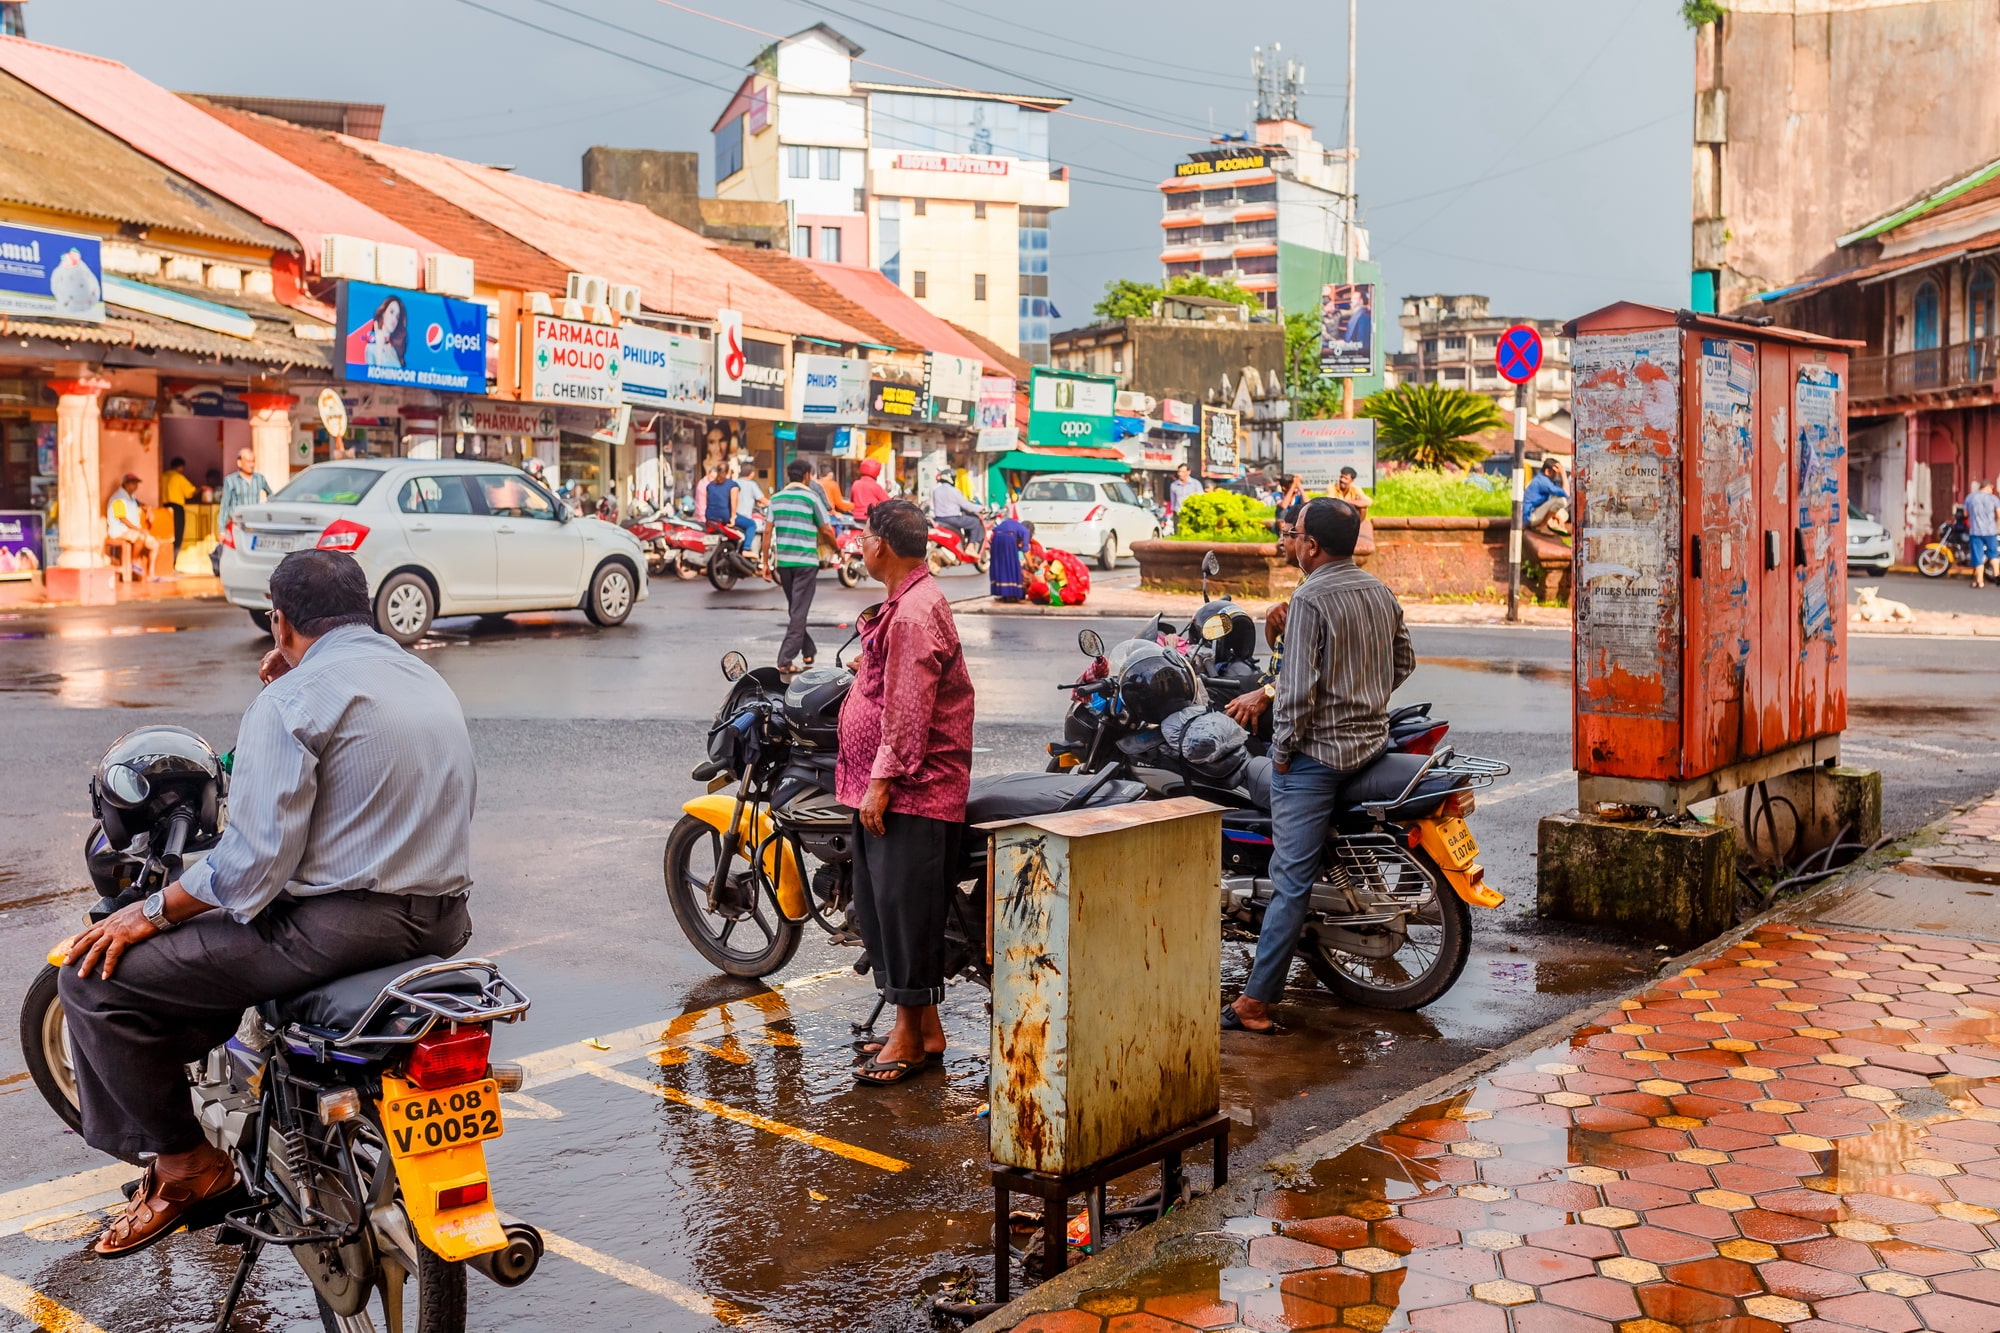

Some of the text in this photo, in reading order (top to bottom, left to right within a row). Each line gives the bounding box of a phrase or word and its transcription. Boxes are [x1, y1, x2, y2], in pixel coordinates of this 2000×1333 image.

[901, 156, 944, 171] HOTEL
[1177, 155, 1265, 177] HOTEL POONAM
[445, 333, 482, 353] pepsi
[537, 320, 620, 351] FARMACIA
[553, 347, 605, 371] MOLIO
[623, 345, 667, 368] PHILIPS
[367, 366, 469, 389] KOHINOOR RESTAURANT
[807, 373, 838, 388] PHILIPS
[552, 382, 605, 402] CHEMIST
[475, 412, 539, 433] PHARMACY
[1061, 420, 1092, 437] oppo
[1594, 586, 1658, 597] PILES CLINIC
